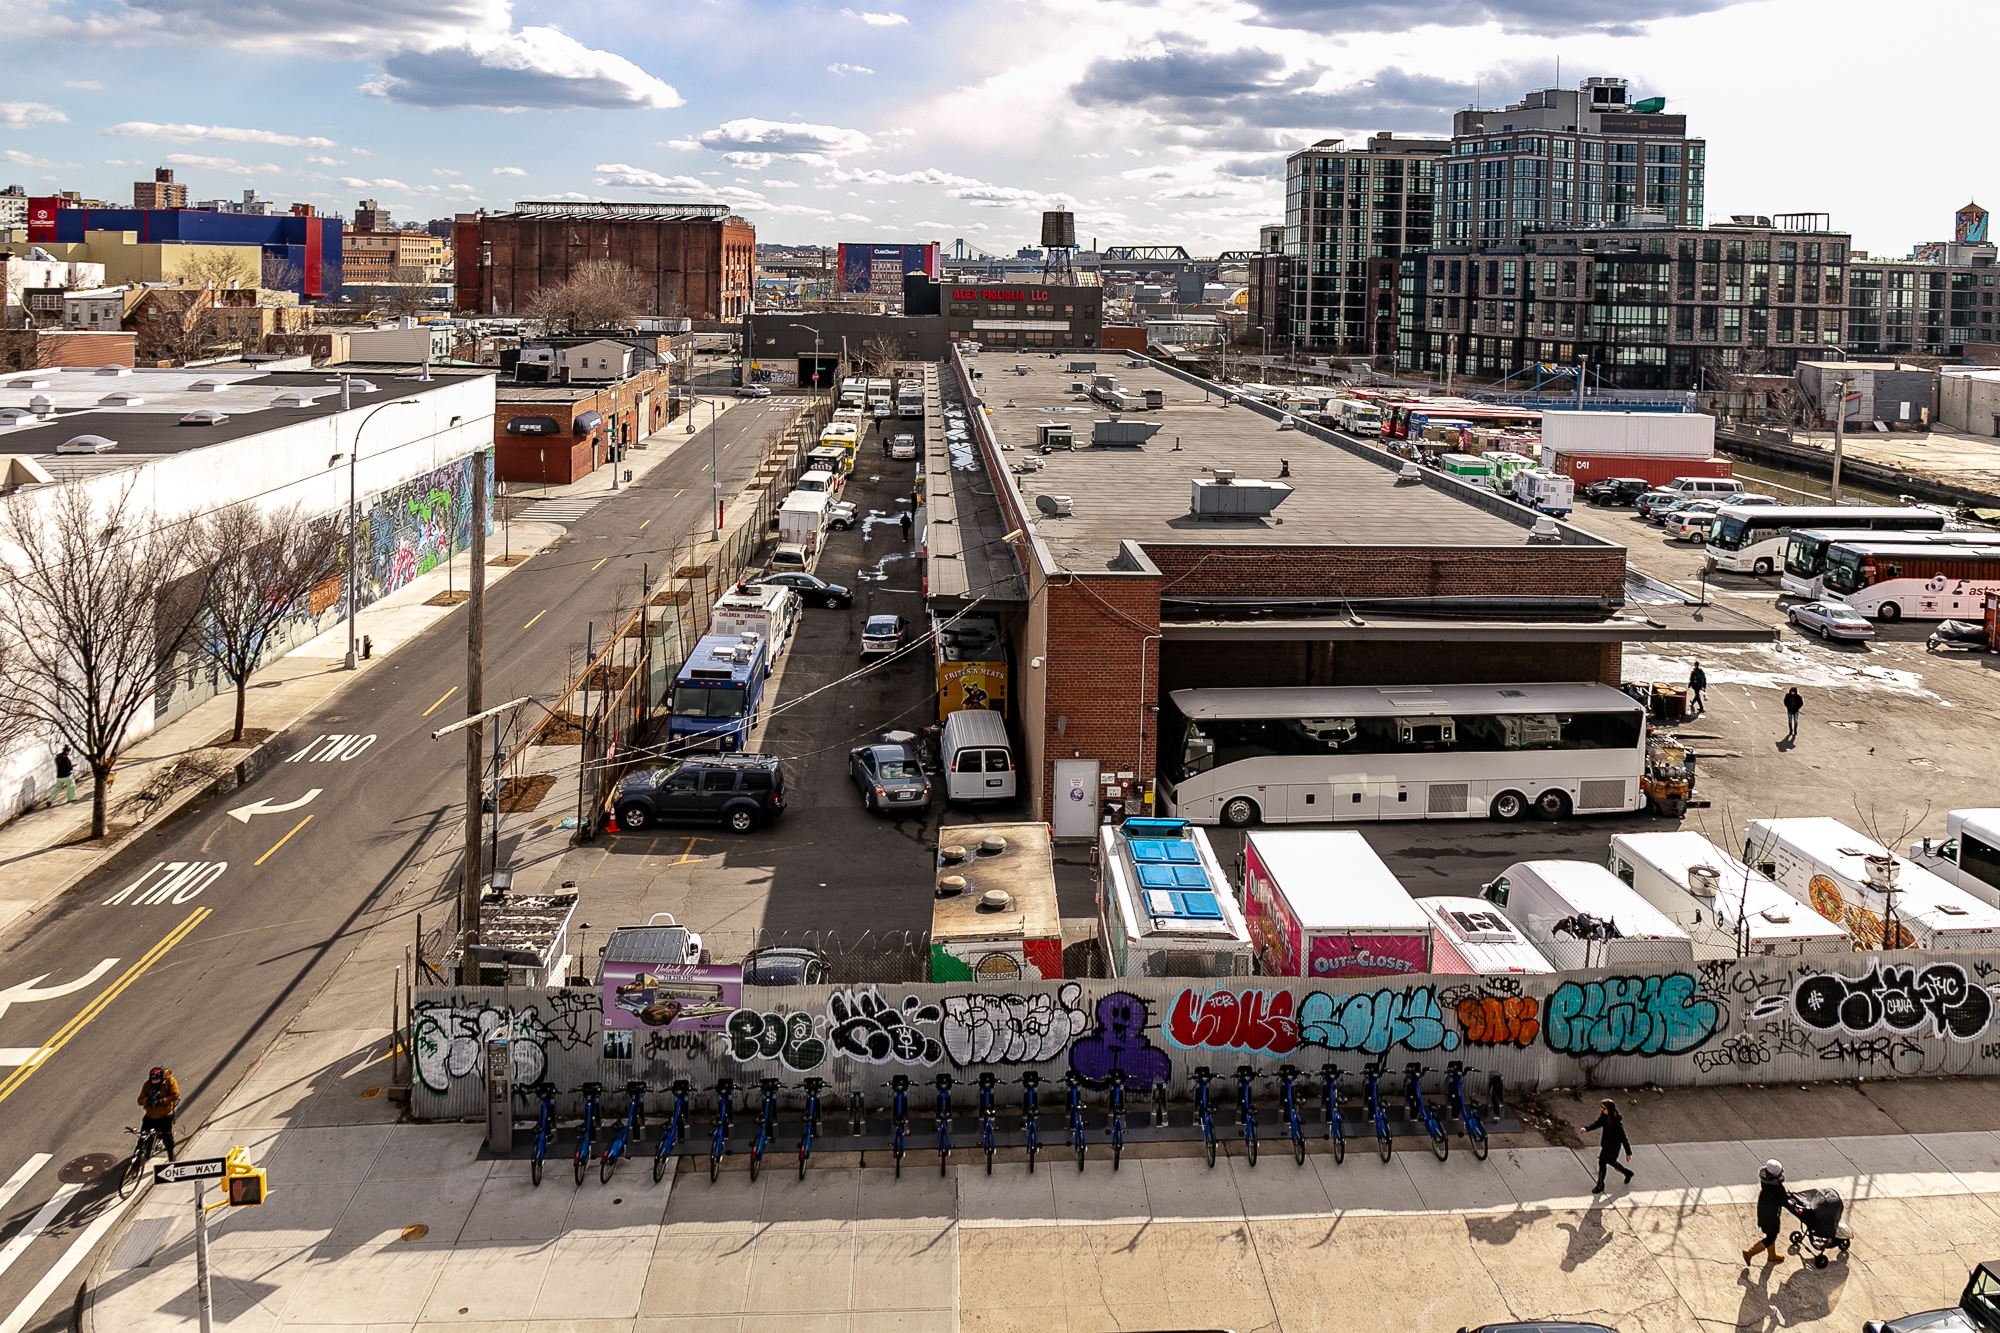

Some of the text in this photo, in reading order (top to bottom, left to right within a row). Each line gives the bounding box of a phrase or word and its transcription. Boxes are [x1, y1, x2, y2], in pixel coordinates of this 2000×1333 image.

[953, 289, 1049, 301] ALEX FIGLIOLIA LLC
[1576, 460, 1590, 470] CAI
[284, 734, 378, 763] ONLY
[101, 861, 229, 906] ONLY
[1314, 955, 1348, 973] OUT
[1356, 950, 1413, 973] CLOSET
[165, 1163, 218, 1178] ONE WAY
